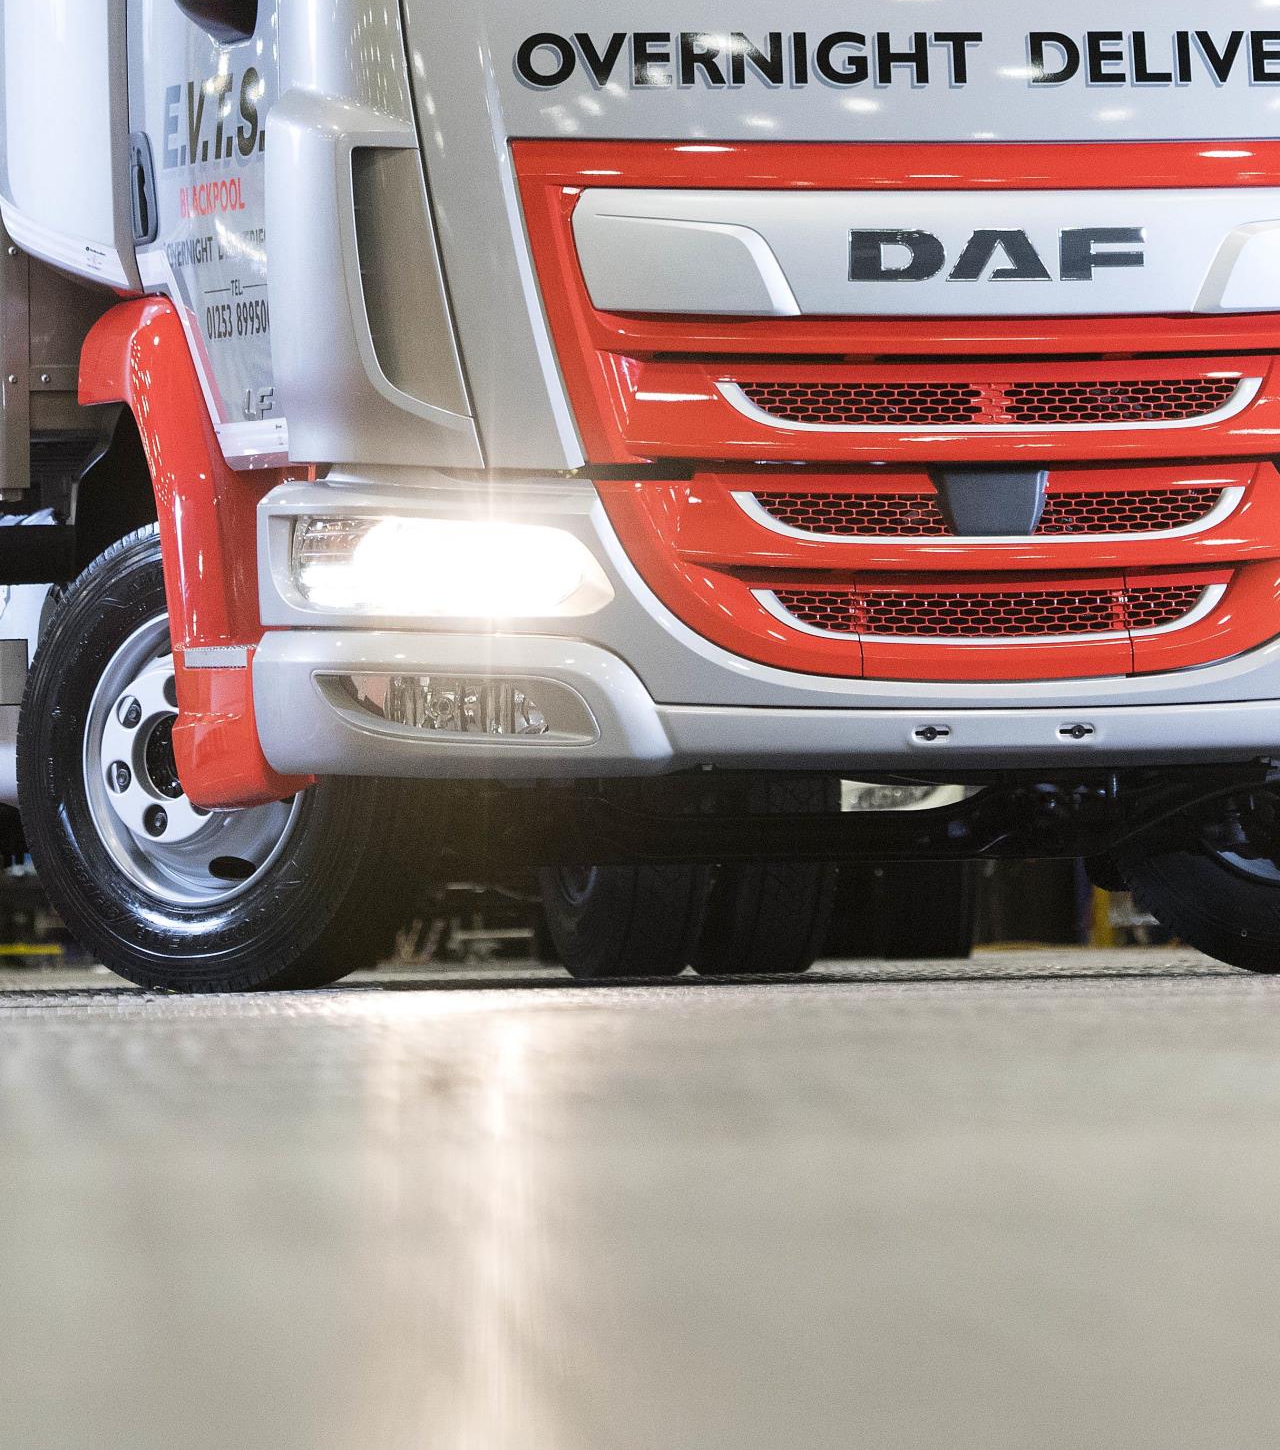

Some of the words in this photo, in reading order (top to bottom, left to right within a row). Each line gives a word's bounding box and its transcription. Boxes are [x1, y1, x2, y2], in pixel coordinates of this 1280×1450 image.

[516, 30, 982, 91] OVERNIGHT
[179, 177, 245, 218] BLACKPOOL
[166, 236, 213, 269] OVERNIGHT
[847, 227, 1148, 283] DAF
[206, 304, 233, 340] 01253
[236, 299, 270, 337] 89950
[242, 386, 275, 421] LF
